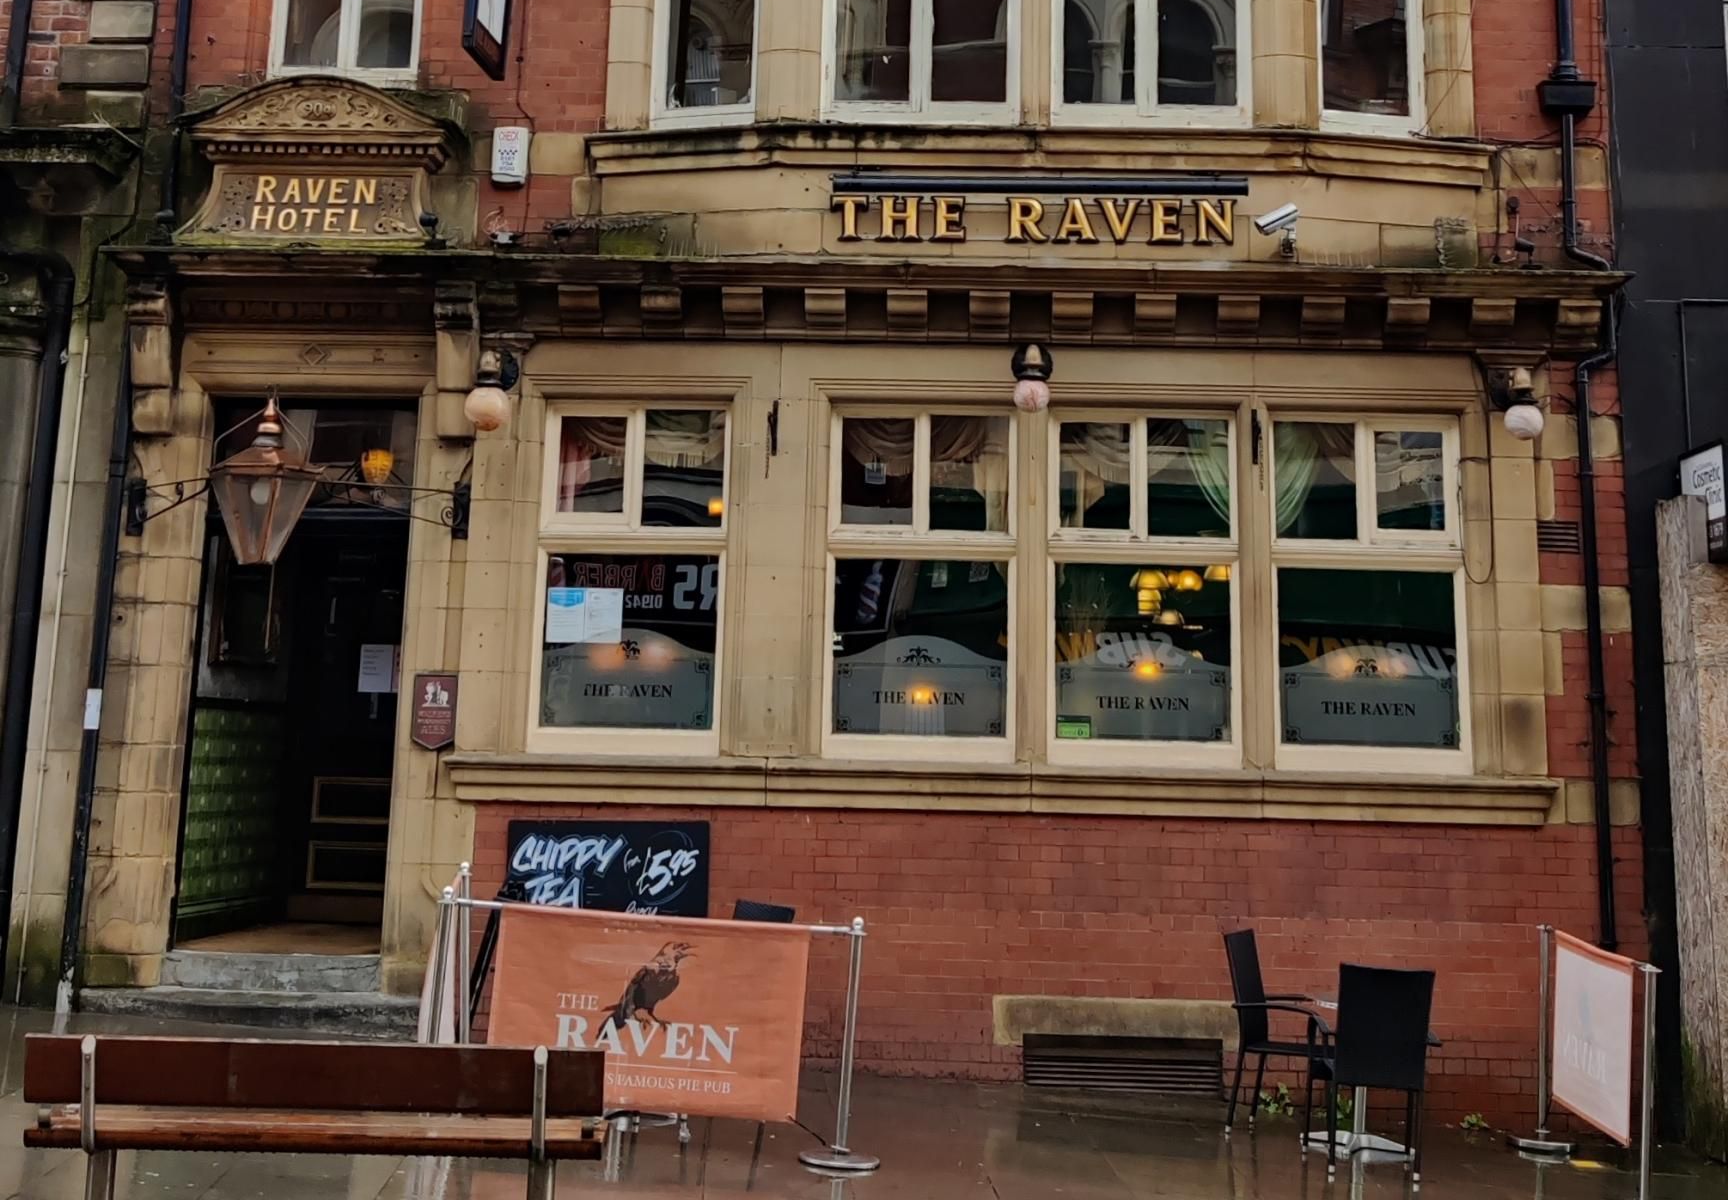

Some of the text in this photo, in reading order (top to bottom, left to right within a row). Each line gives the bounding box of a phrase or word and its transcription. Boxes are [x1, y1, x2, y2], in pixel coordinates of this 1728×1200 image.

[254, 175, 376, 204] RAVEN
[250, 205, 367, 233] HOTEL
[830, 195, 1238, 246] THE RAVEN
[1693, 464, 1721, 489] Cosmetic
[872, 691, 906, 704] THE
[1096, 696, 1190, 711] THE RAVEN
[1321, 701, 1416, 716] THE RAVEN
[512, 836, 624, 872] CHIPPY
[525, 872, 580, 909] TEA
[557, 992, 599, 1011] THE
[555, 1013, 739, 1064] RAVEN
[617, 1073, 674, 1090] FAMOUS
[678, 1077, 700, 1091] PIE
[704, 1080, 731, 1094] PUB
